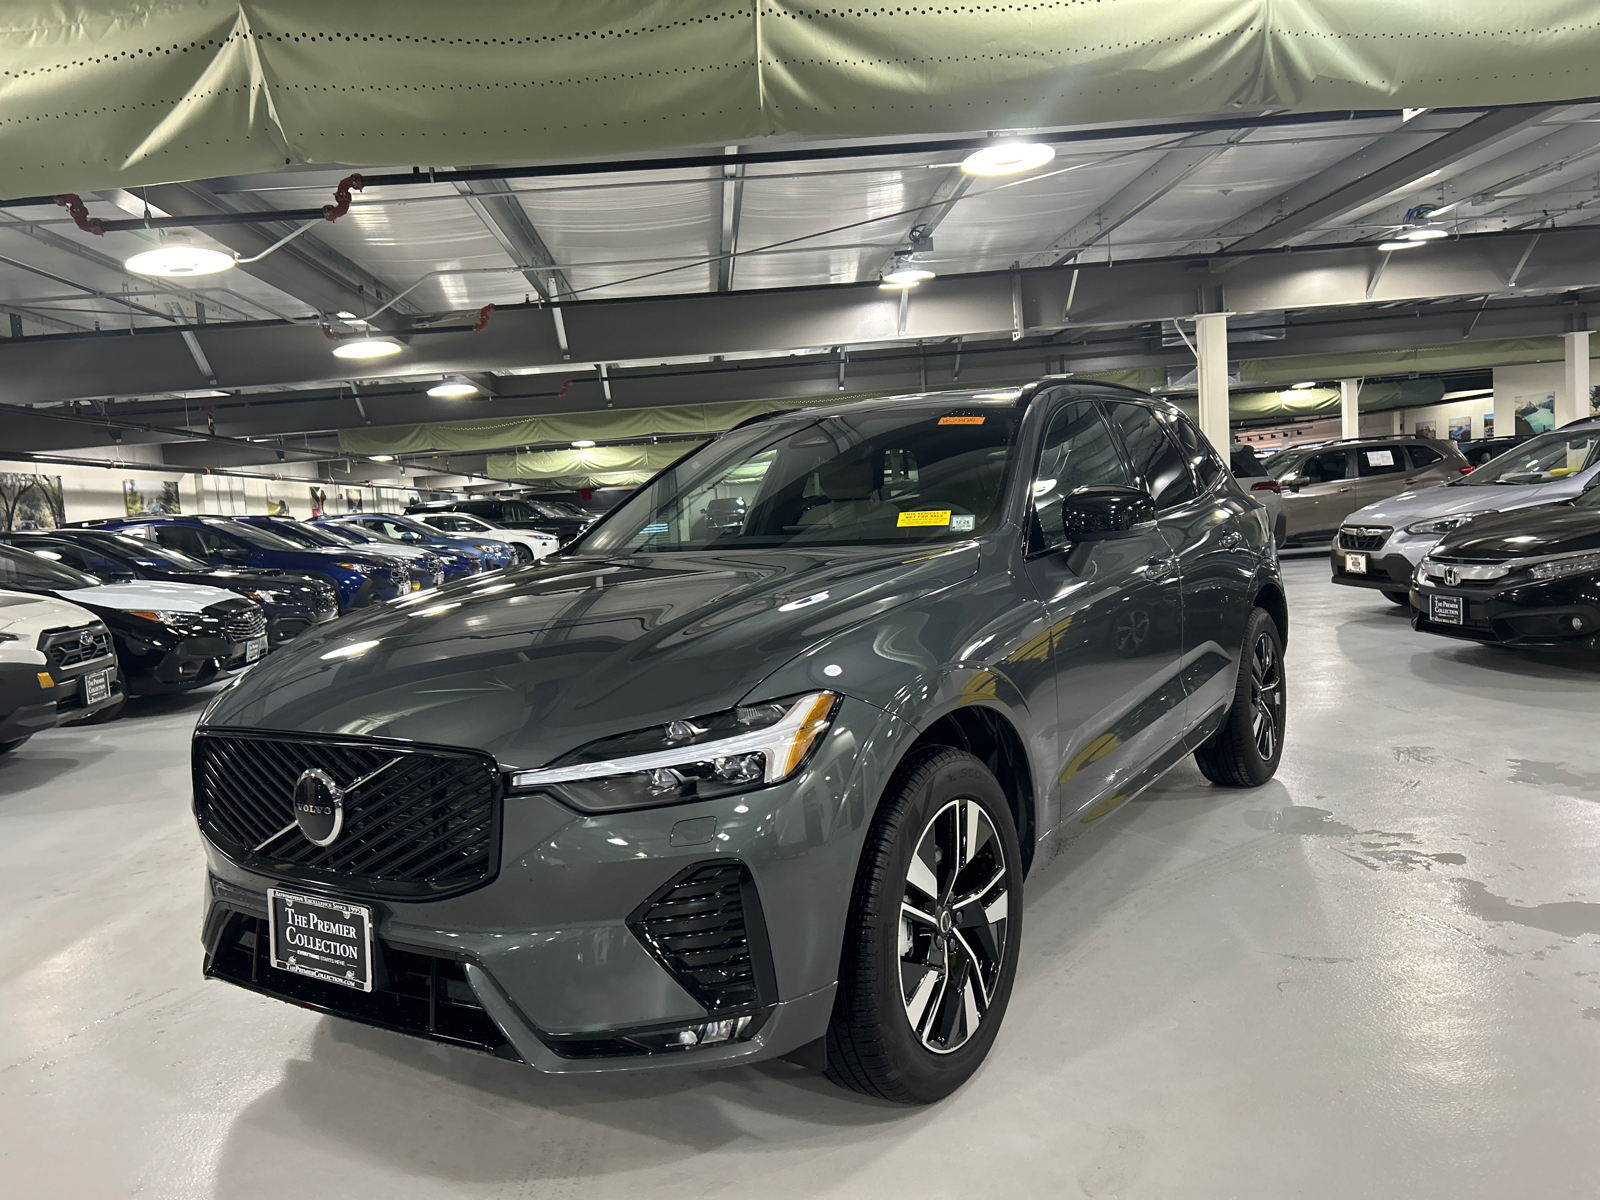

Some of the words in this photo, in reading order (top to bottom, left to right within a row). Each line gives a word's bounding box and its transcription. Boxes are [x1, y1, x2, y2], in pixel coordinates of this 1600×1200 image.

[1434, 607, 1458, 615] COLLECTION
[296, 803, 332, 815] VOLVO
[285, 907, 308, 928] THE
[309, 912, 357, 939] PREMIER
[286, 926, 358, 960] COLLECTION
